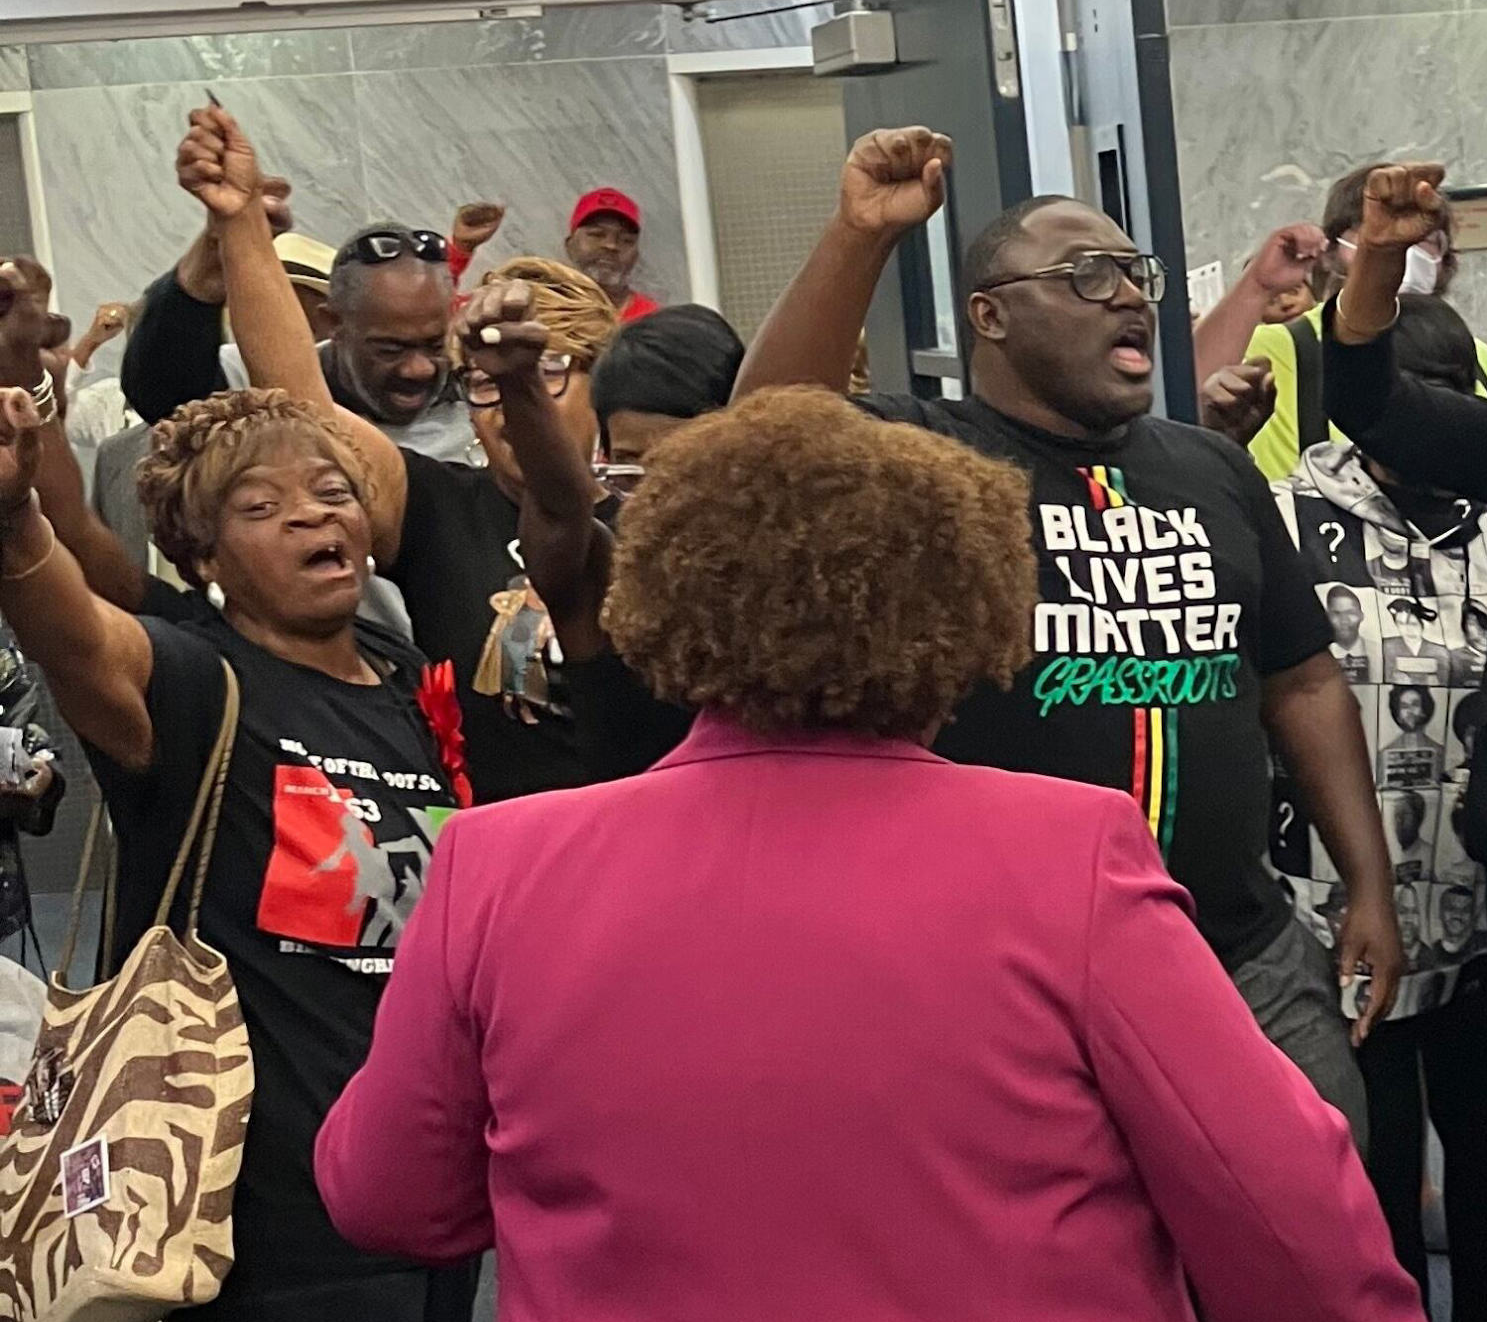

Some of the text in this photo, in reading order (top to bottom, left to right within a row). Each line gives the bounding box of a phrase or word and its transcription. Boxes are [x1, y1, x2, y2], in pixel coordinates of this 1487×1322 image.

[1039, 504, 1211, 553] BLACK
[1055, 551, 1217, 605] LIVES
[1034, 602, 1242, 656] MATTER
[1033, 654, 1241, 718] GRASSROOTS
